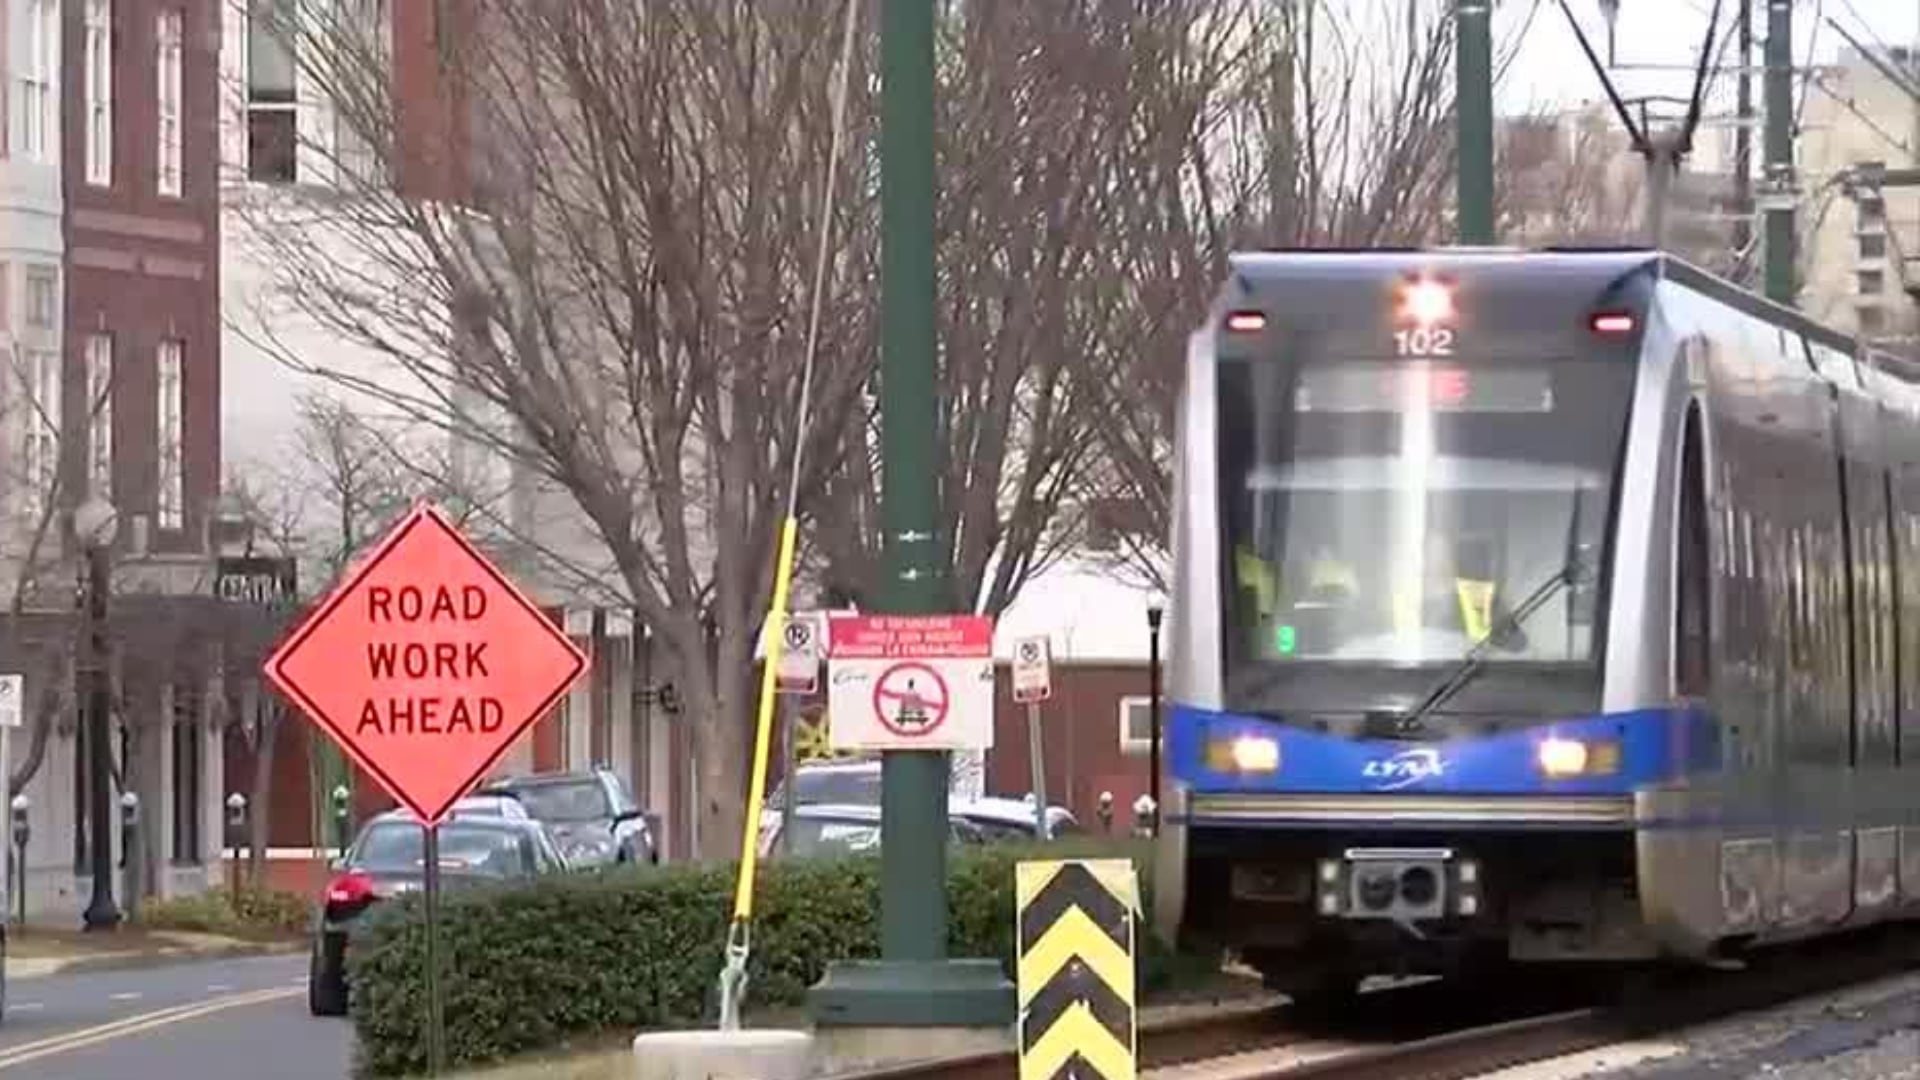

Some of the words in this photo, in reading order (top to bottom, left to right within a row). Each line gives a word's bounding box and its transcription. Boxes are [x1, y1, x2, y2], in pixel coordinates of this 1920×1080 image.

[1394, 329, 1454, 355] 102
[368, 585, 487, 622] ROAD
[367, 643, 489, 679] WORK
[356, 698, 504, 734] AHEAD
